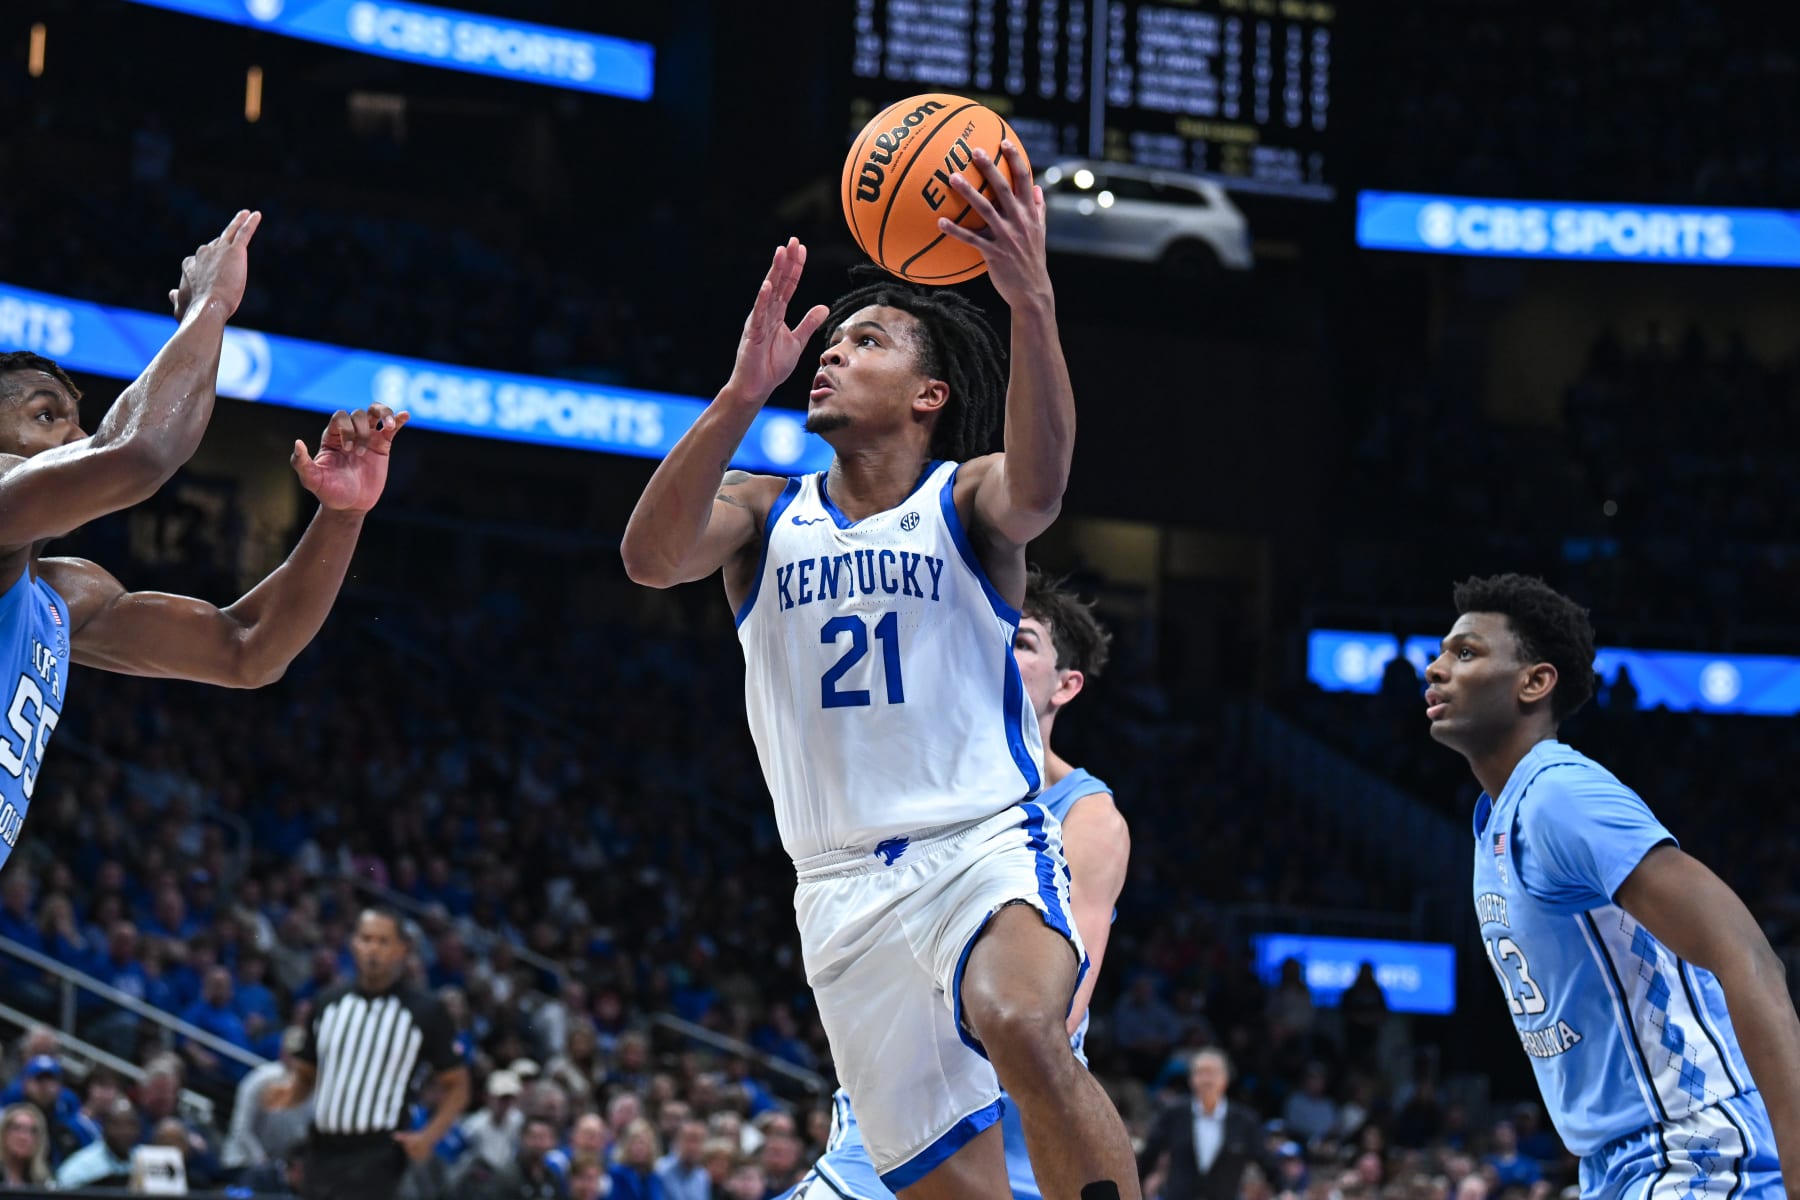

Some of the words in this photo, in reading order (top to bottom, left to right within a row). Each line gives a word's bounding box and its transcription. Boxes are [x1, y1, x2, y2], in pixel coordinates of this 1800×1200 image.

[376, 8, 450, 58] CBS
[452, 21, 597, 82] SPORTS
[856, 101, 948, 203] Wilson
[961, 120, 976, 141] NXT
[1457, 205, 1548, 253] CBS
[1551, 209, 1734, 260] SPORTS
[408, 371, 493, 427] CBS
[496, 383, 665, 448] SPORTS
[901, 512, 920, 531] SEC
[776, 549, 945, 612] KENTUCKY
[820, 611, 905, 709] 21
[1486, 936, 1547, 1015] 13
